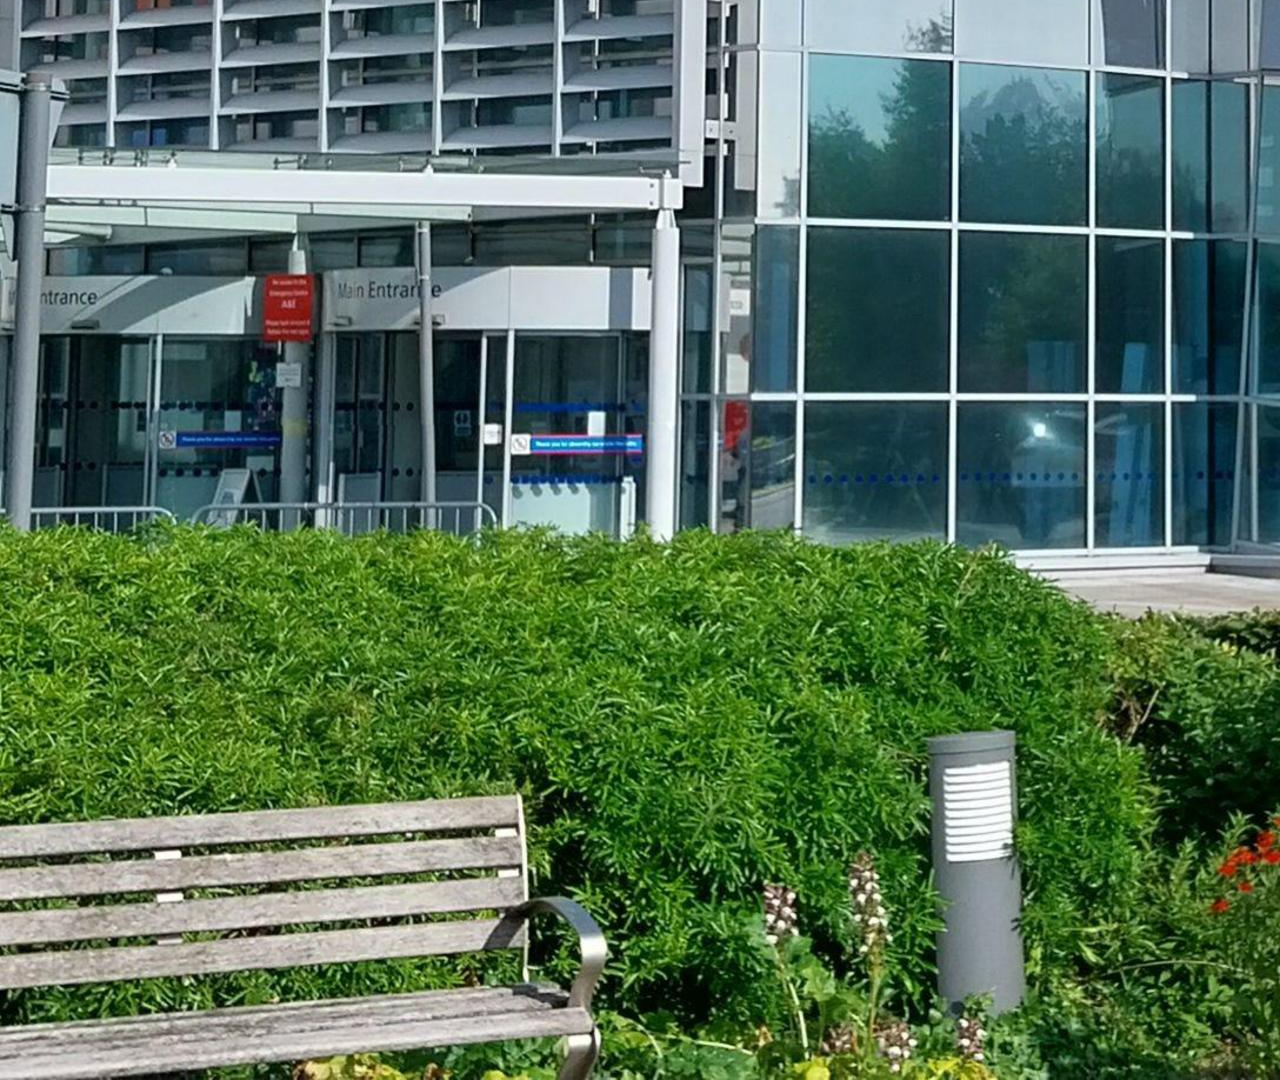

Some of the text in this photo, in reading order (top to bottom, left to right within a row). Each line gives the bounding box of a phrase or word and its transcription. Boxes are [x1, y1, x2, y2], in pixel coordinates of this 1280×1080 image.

[40, 289, 97, 305] ntrance
[338, 281, 442, 299] Main Entrane
